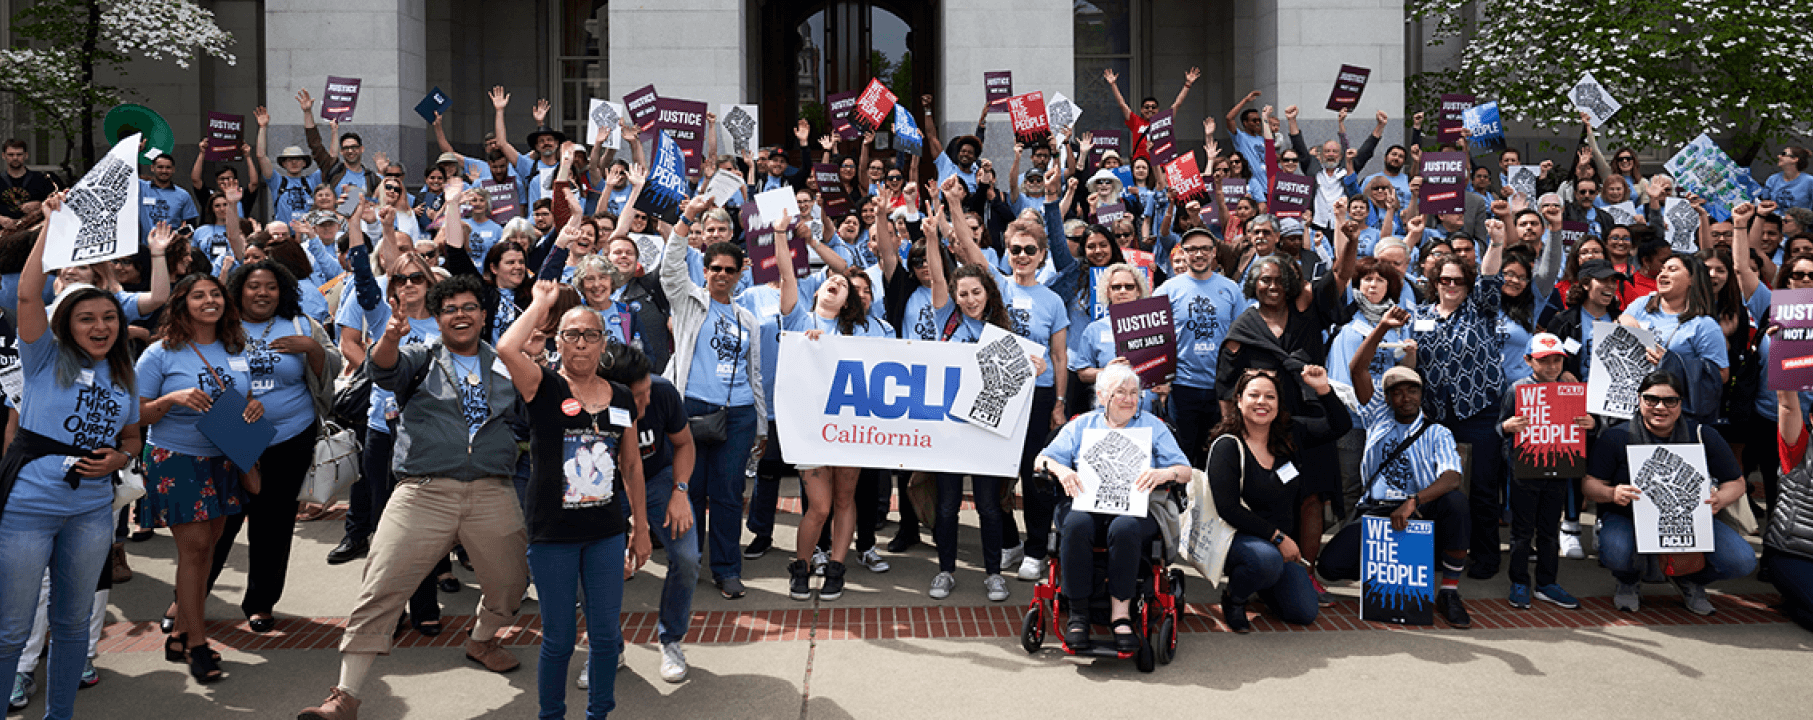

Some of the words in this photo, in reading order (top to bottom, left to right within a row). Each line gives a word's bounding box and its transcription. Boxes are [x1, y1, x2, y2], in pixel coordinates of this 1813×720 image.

[658, 109, 702, 126] JUSTICE
[1424, 161, 1462, 172] JUSTICE
[1277, 180, 1310, 195] JUSTICE
[76, 243, 115, 259] ACLU
[1117, 310, 1168, 334] JUSTICE
[1127, 338, 1143, 350] NOT
[1144, 333, 1164, 346] JAILS
[1784, 328, 1804, 340] NOT
[1194, 343, 1215, 351] ACLU
[252, 380, 275, 390] CLU
[1521, 386, 1548, 406] WE
[1520, 406, 1551, 424] THE
[1604, 402, 1634, 413] ACLU
[970, 409, 1000, 425] ACLU
[821, 423, 932, 448] California
[1520, 424, 1579, 444] PEOPLE
[1367, 519, 1394, 541] WE
[1662, 535, 1694, 547] ACLU
[1366, 540, 1398, 563] THE
[1367, 560, 1427, 587] PEOPLE
